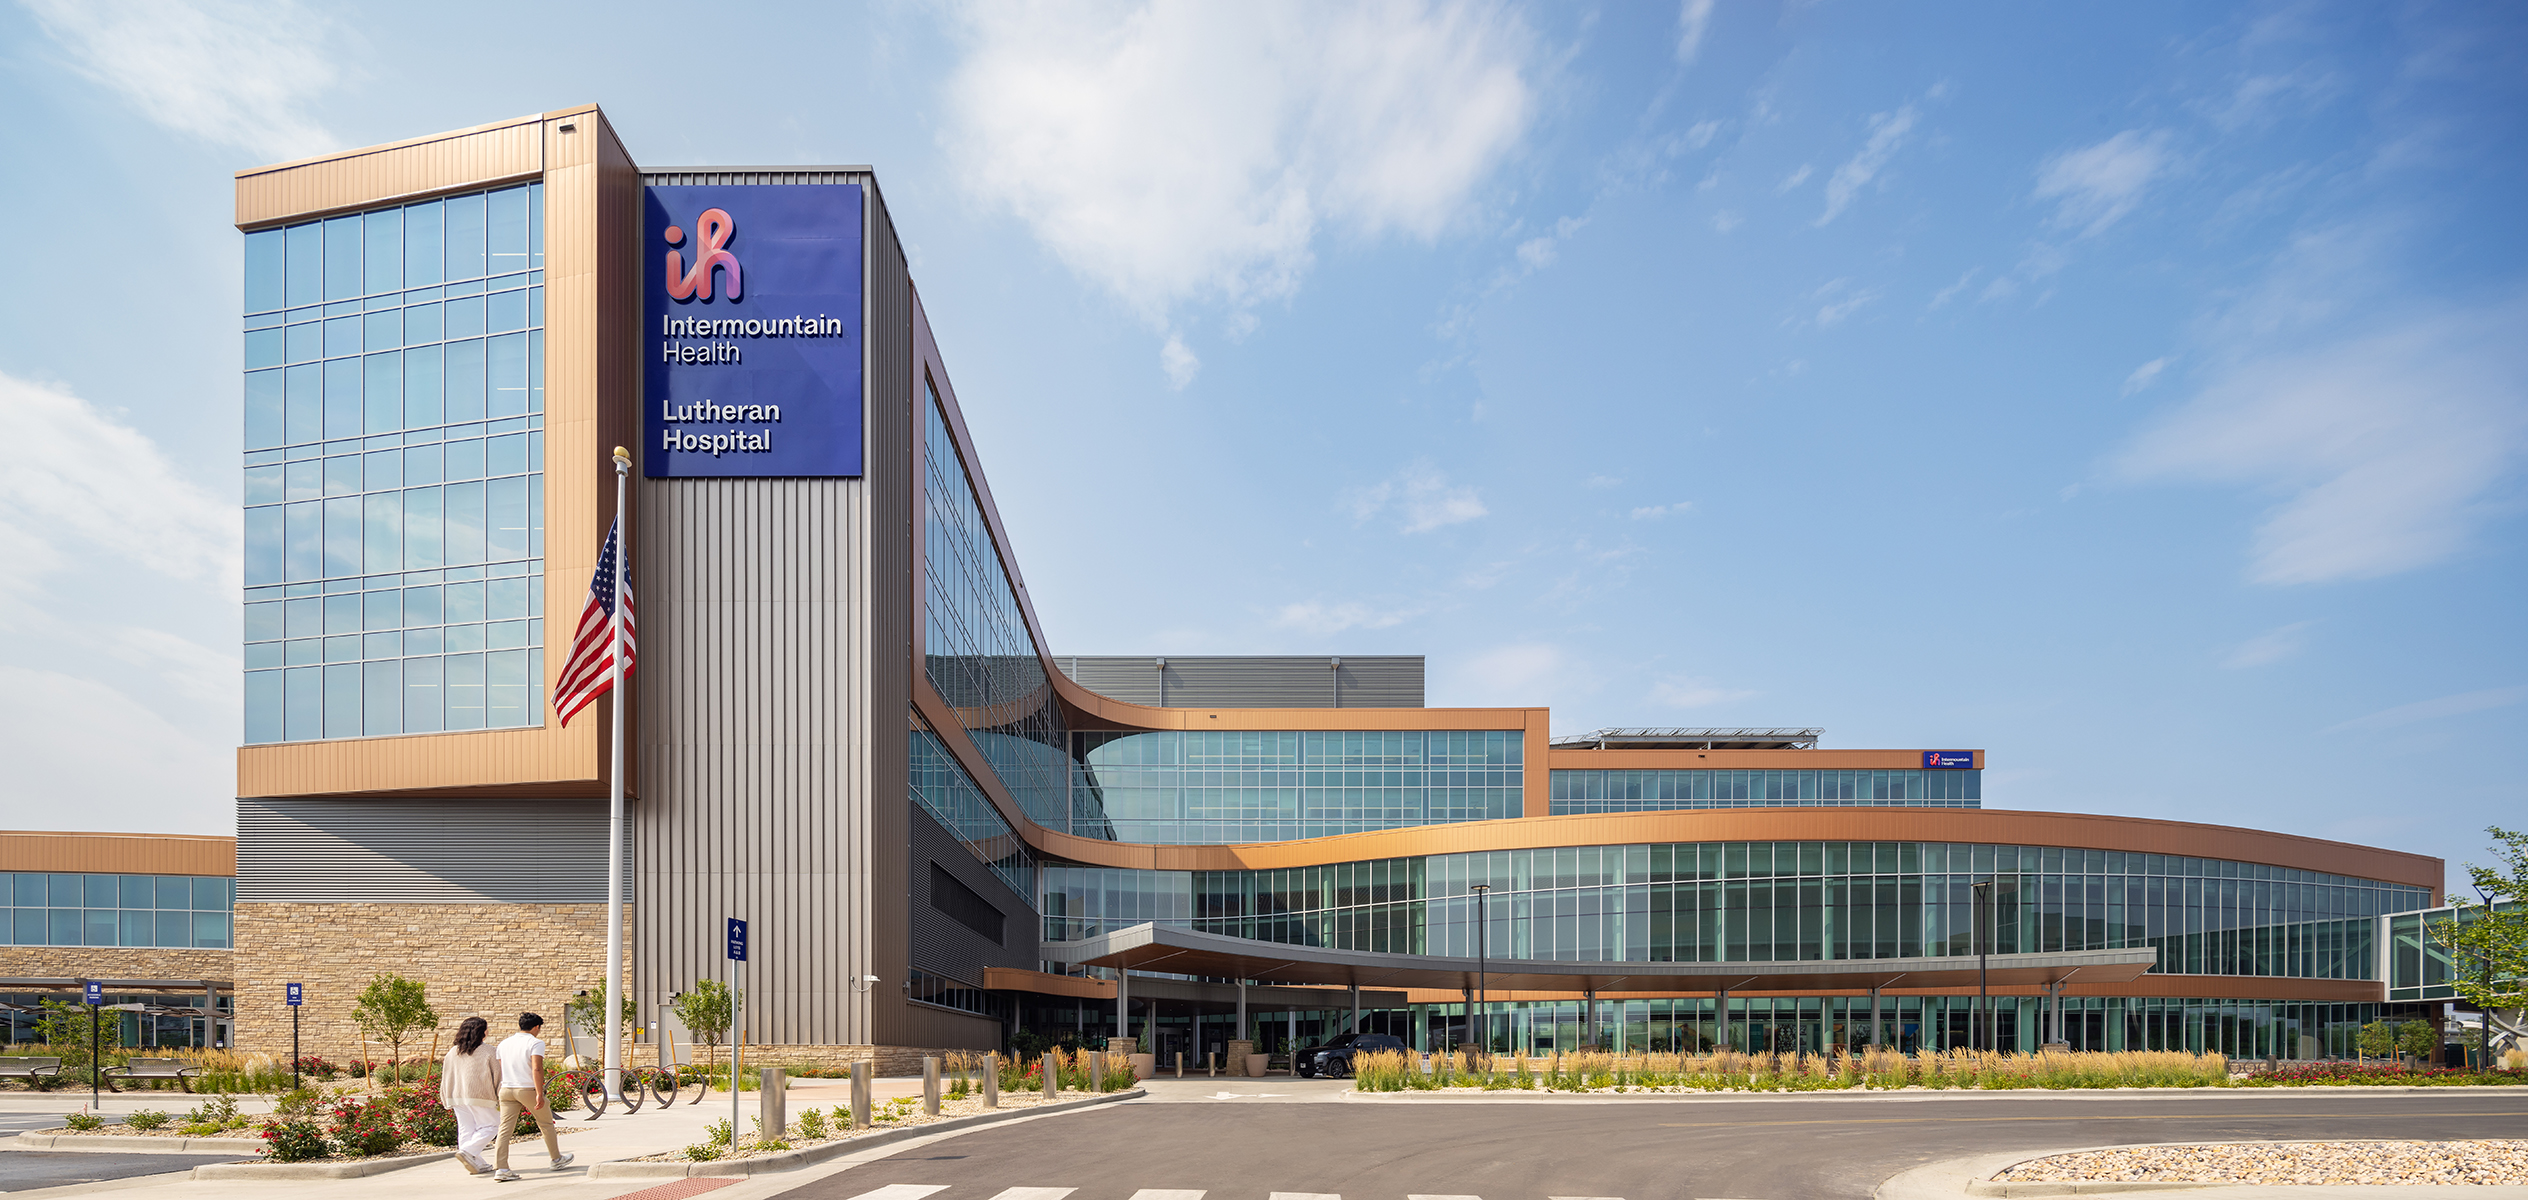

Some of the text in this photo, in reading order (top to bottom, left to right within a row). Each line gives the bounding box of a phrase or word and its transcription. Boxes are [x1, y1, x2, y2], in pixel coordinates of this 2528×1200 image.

[663, 313, 842, 336] Intermountain
[663, 341, 740, 362] Health
[663, 399, 780, 421] Lutheran
[663, 428, 770, 455] Hospital
